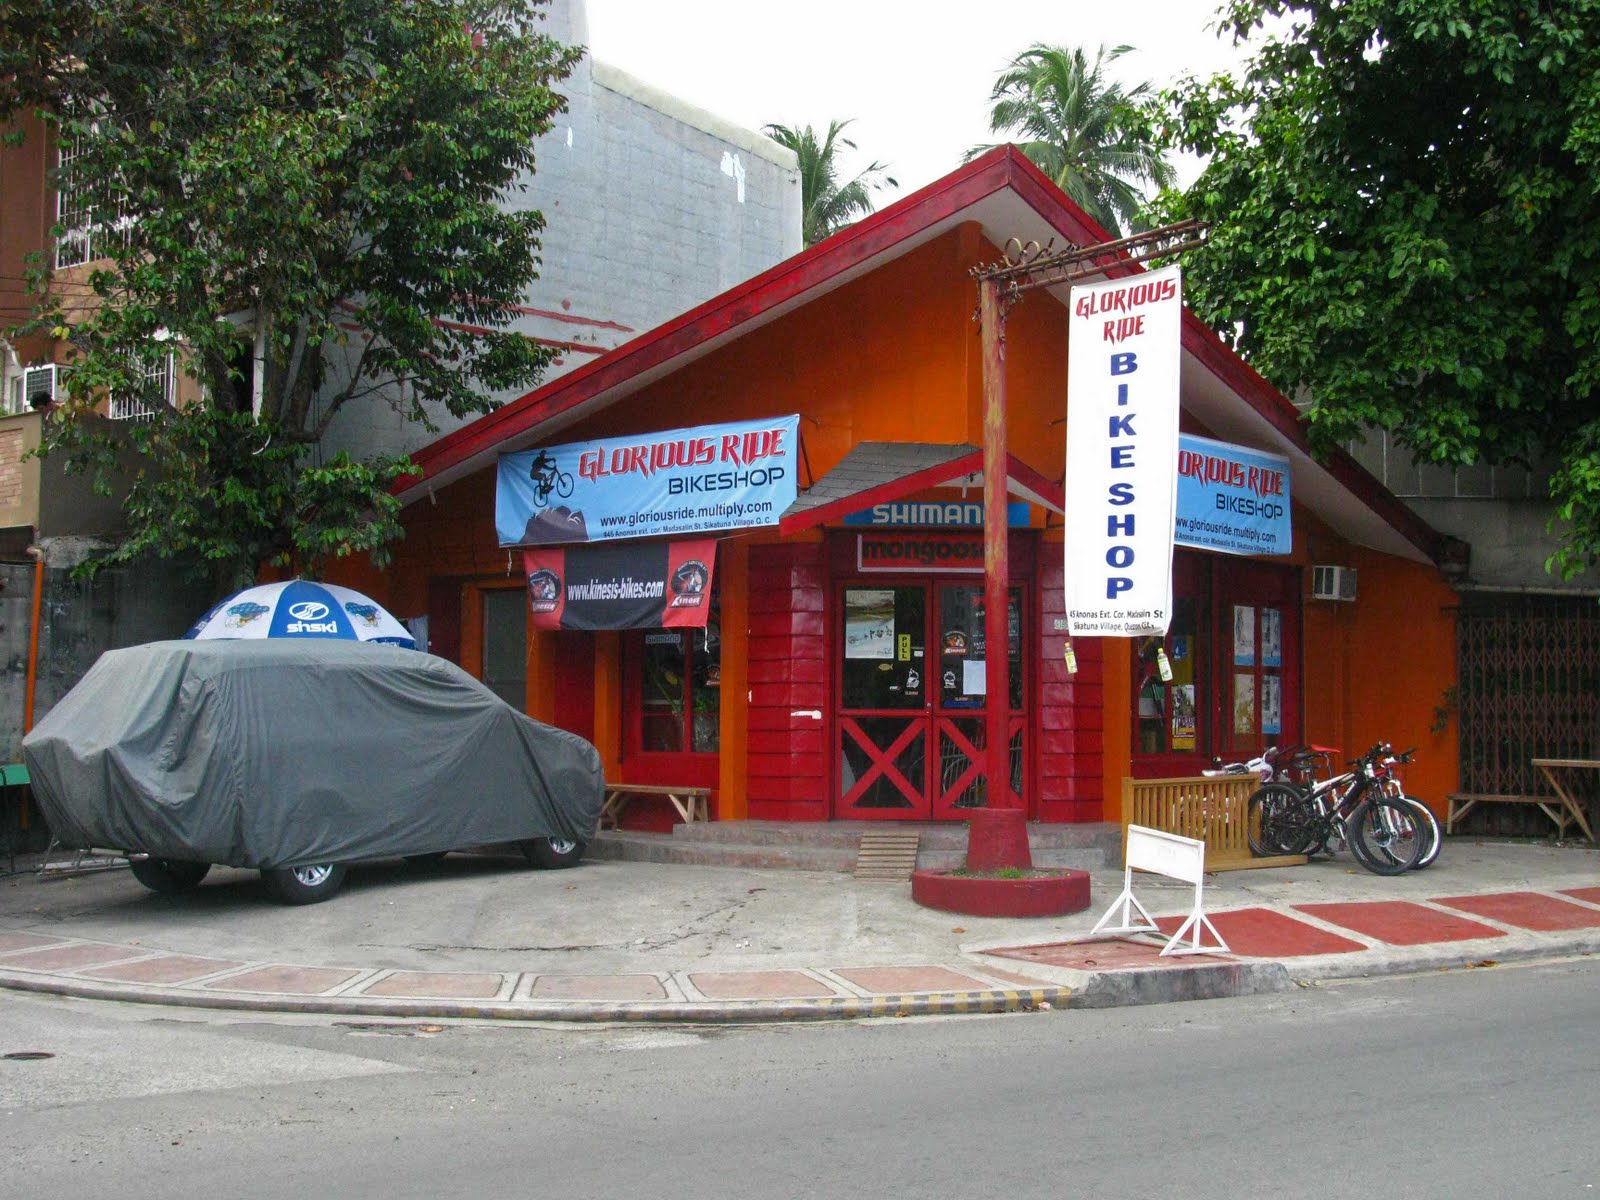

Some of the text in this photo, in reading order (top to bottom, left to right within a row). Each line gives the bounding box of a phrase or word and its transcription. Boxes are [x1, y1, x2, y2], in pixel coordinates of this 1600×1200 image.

[1075, 278, 1176, 320] GLORIOUS
[1103, 314, 1145, 345] RIDE
[578, 428, 788, 483] GLORIOUS RIDE
[668, 466, 785, 495] BIKESHOP
[1178, 450, 1285, 499] ORIOUS RIDE
[600, 501, 773, 527] www.gloriousride.multiply.com
[872, 503, 984, 524] SHIMAN
[1216, 493, 1283, 520] BIKESHOP
[615, 528, 637, 537] Anonas
[704, 519, 732, 530] Sikatuna
[733, 517, 755, 528] Village
[1175, 516, 1276, 542] ww.gloriousride.multiply.com
[863, 541, 985, 565] mongoos
[567, 576, 664, 601] www.kinesis-bikes.com
[1099, 610, 1111, 619] Ext.
[1113, 610, 1125, 619] Cor.
[1153, 609, 1164, 619] St
